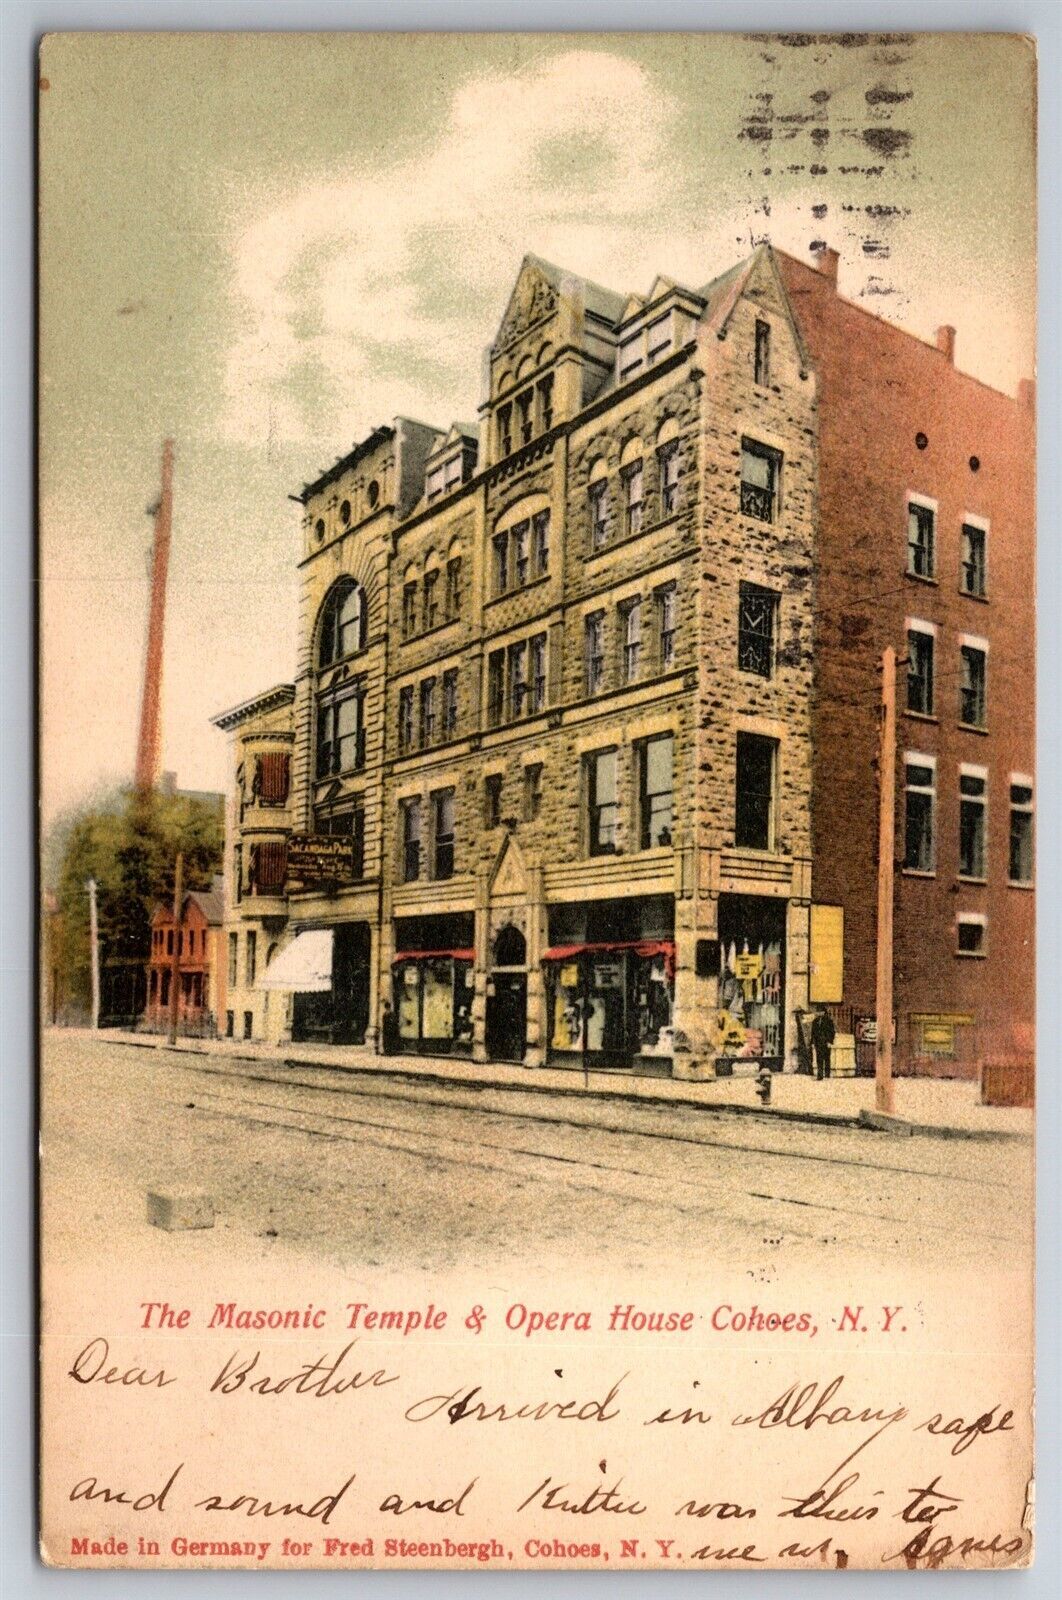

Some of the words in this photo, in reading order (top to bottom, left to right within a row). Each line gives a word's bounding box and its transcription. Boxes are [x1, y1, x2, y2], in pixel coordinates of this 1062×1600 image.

[140, 1302, 192, 1330] The
[207, 1302, 327, 1330] Masonic
[346, 1303, 447, 1336] Temple
[464, 1305, 488, 1332] &
[505, 1304, 591, 1338] Opera
[608, 1304, 694, 1332] House
[711, 1303, 818, 1338] Cohoes,
[837, 1305, 868, 1332] N.
[881, 1305, 908, 1332] Y.
[68, 1337, 178, 1385] Dear
[210, 1335, 400, 1398] Brother
[405, 1368, 630, 1425] Arrived
[643, 1380, 712, 1426] in
[731, 1374, 910, 1472] Albany
[69, 1463, 185, 1512] and
[195, 1474, 358, 1525] sound
[379, 1478, 481, 1517] and
[70, 1537, 129, 1557] Made
[137, 1537, 161, 1557] in
[171, 1537, 271, 1562] Germany
[281, 1537, 314, 1557] for
[323, 1538, 374, 1557] Fred
[384, 1538, 514, 1562] Steenbergh,
[524, 1538, 610, 1562] Cohoes,
[620, 1539, 647, 1558] N.
[656, 1539, 683, 1558] Y.
